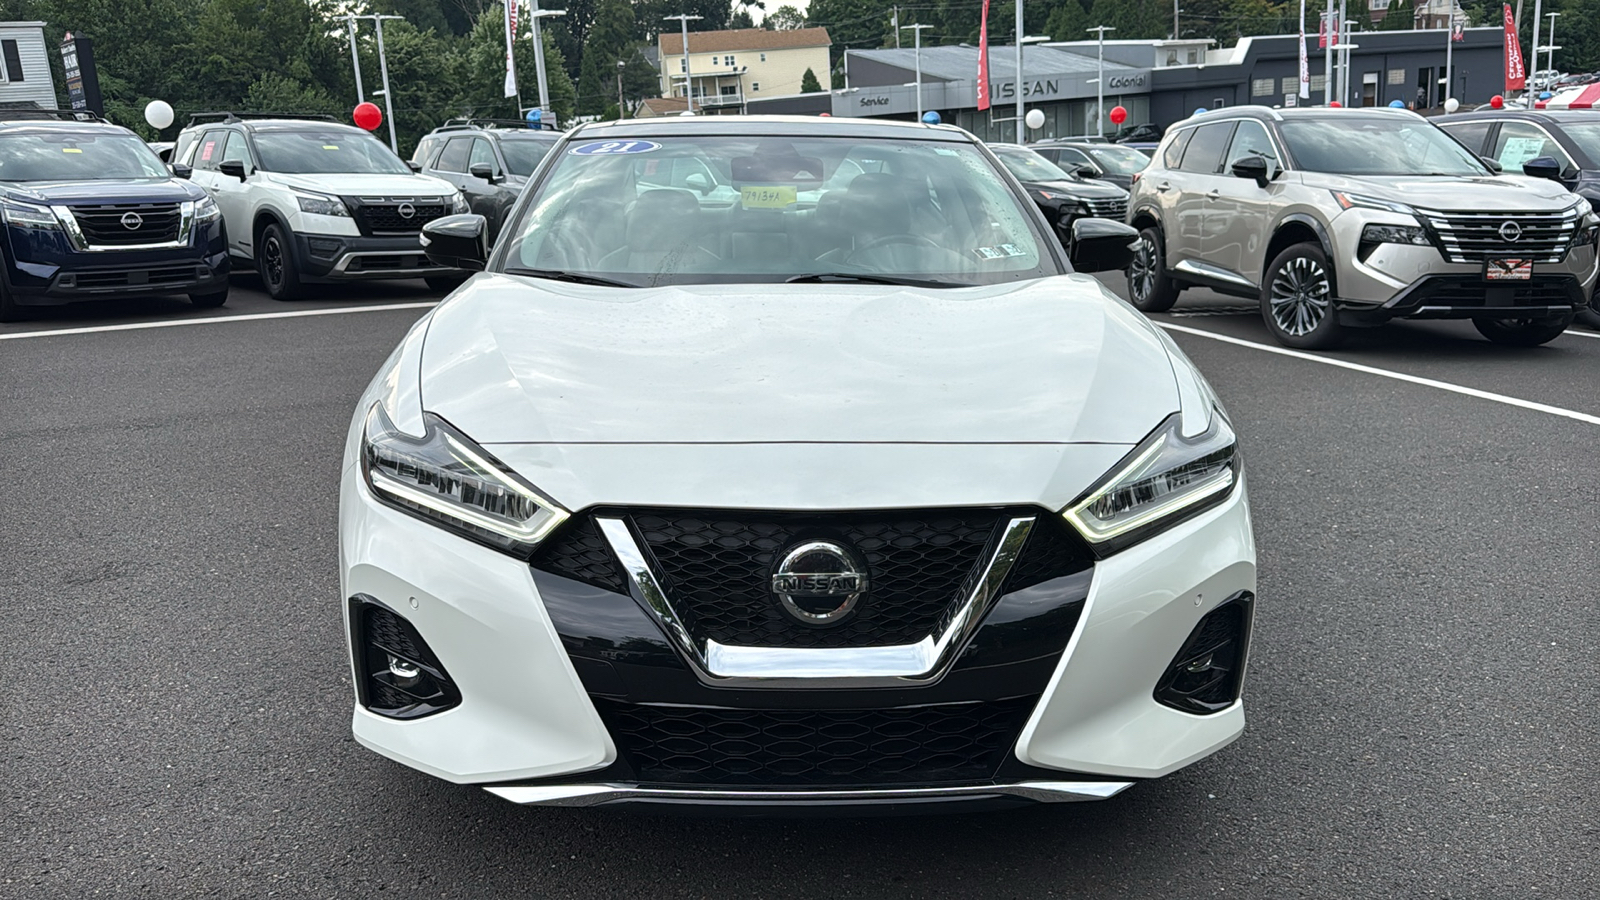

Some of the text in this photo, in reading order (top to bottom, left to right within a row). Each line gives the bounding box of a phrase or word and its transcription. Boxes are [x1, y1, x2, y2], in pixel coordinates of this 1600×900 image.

[1109, 75, 1147, 89] Colonial
[860, 96, 890, 107] Service
[591, 142, 639, 154] 21
[782, 576, 857, 591] NISSAN
